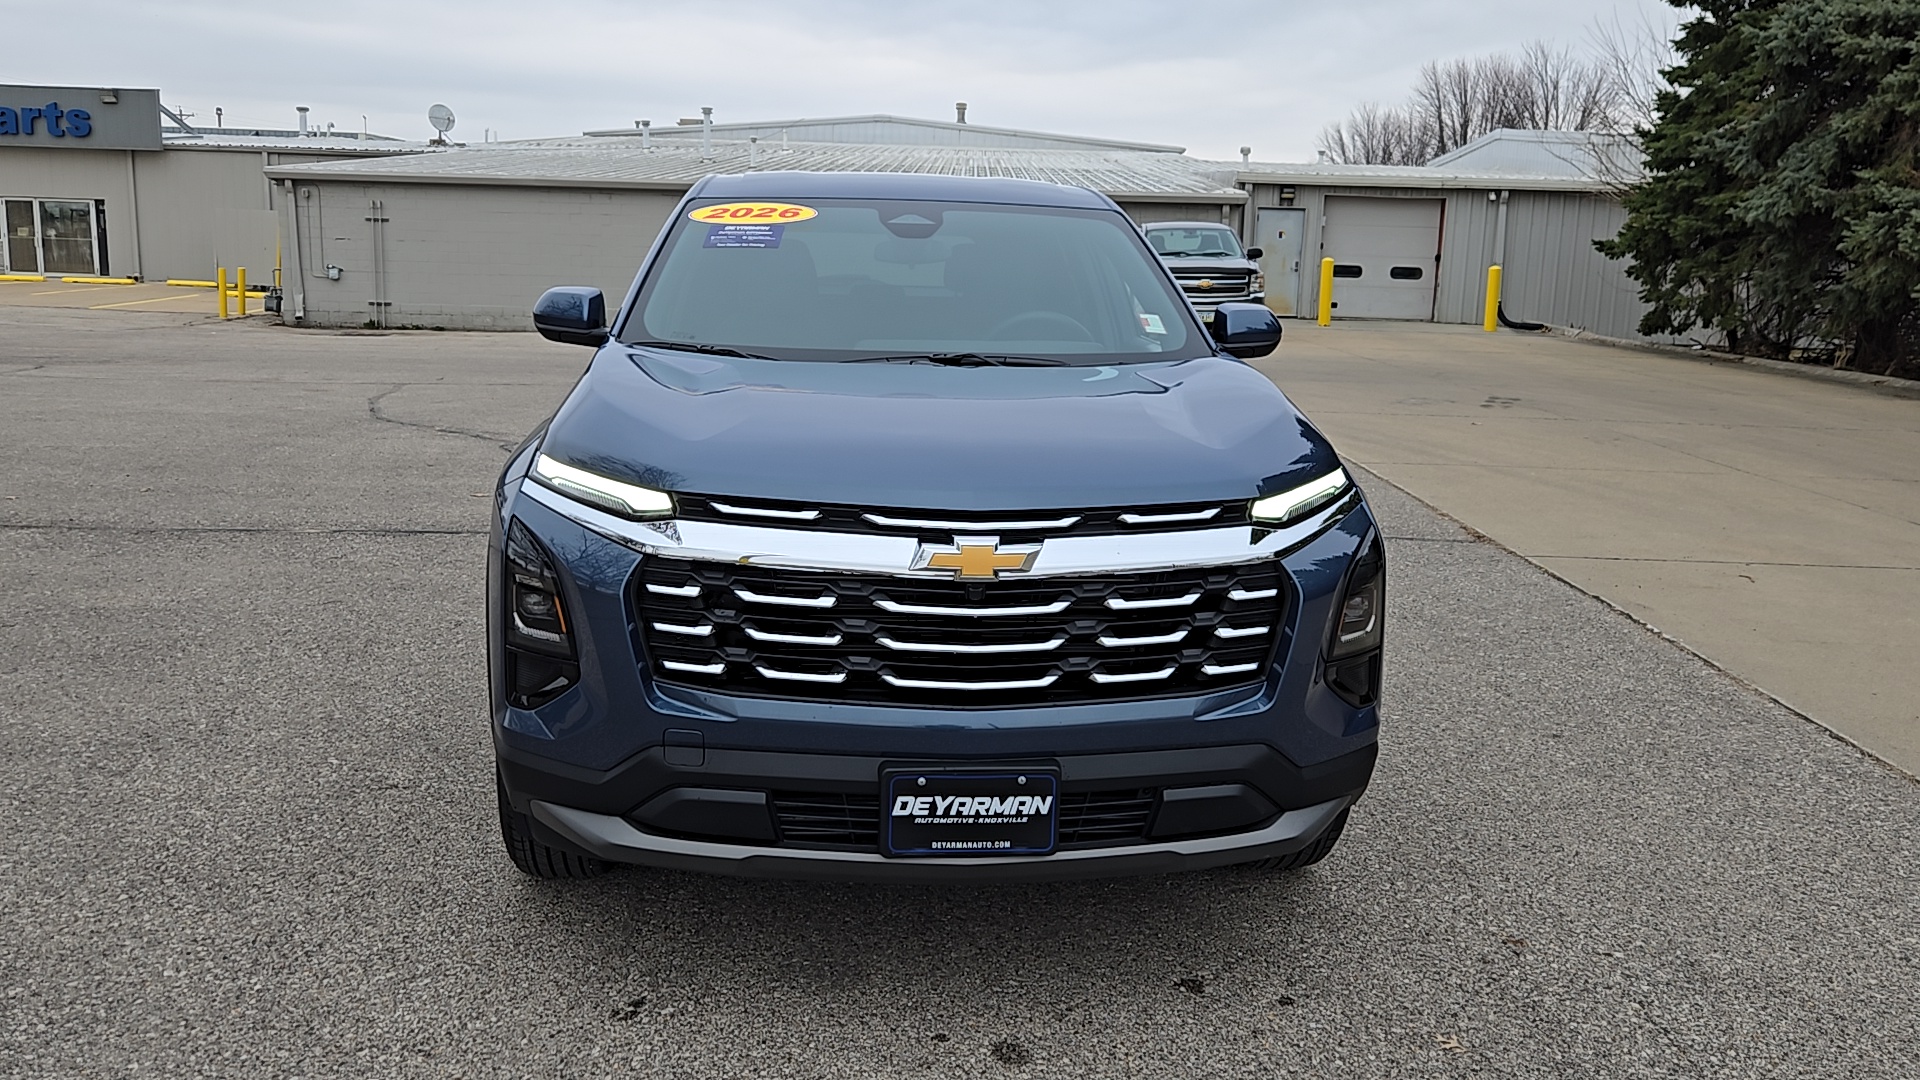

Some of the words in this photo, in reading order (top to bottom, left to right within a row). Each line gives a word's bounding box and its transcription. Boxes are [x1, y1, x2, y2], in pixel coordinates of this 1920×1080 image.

[0, 102, 92, 138] arts
[703, 207, 804, 219] 2026
[892, 796, 1053, 816] DEYARMAN
[931, 840, 1011, 849] DEYARMANAUTO.COM
